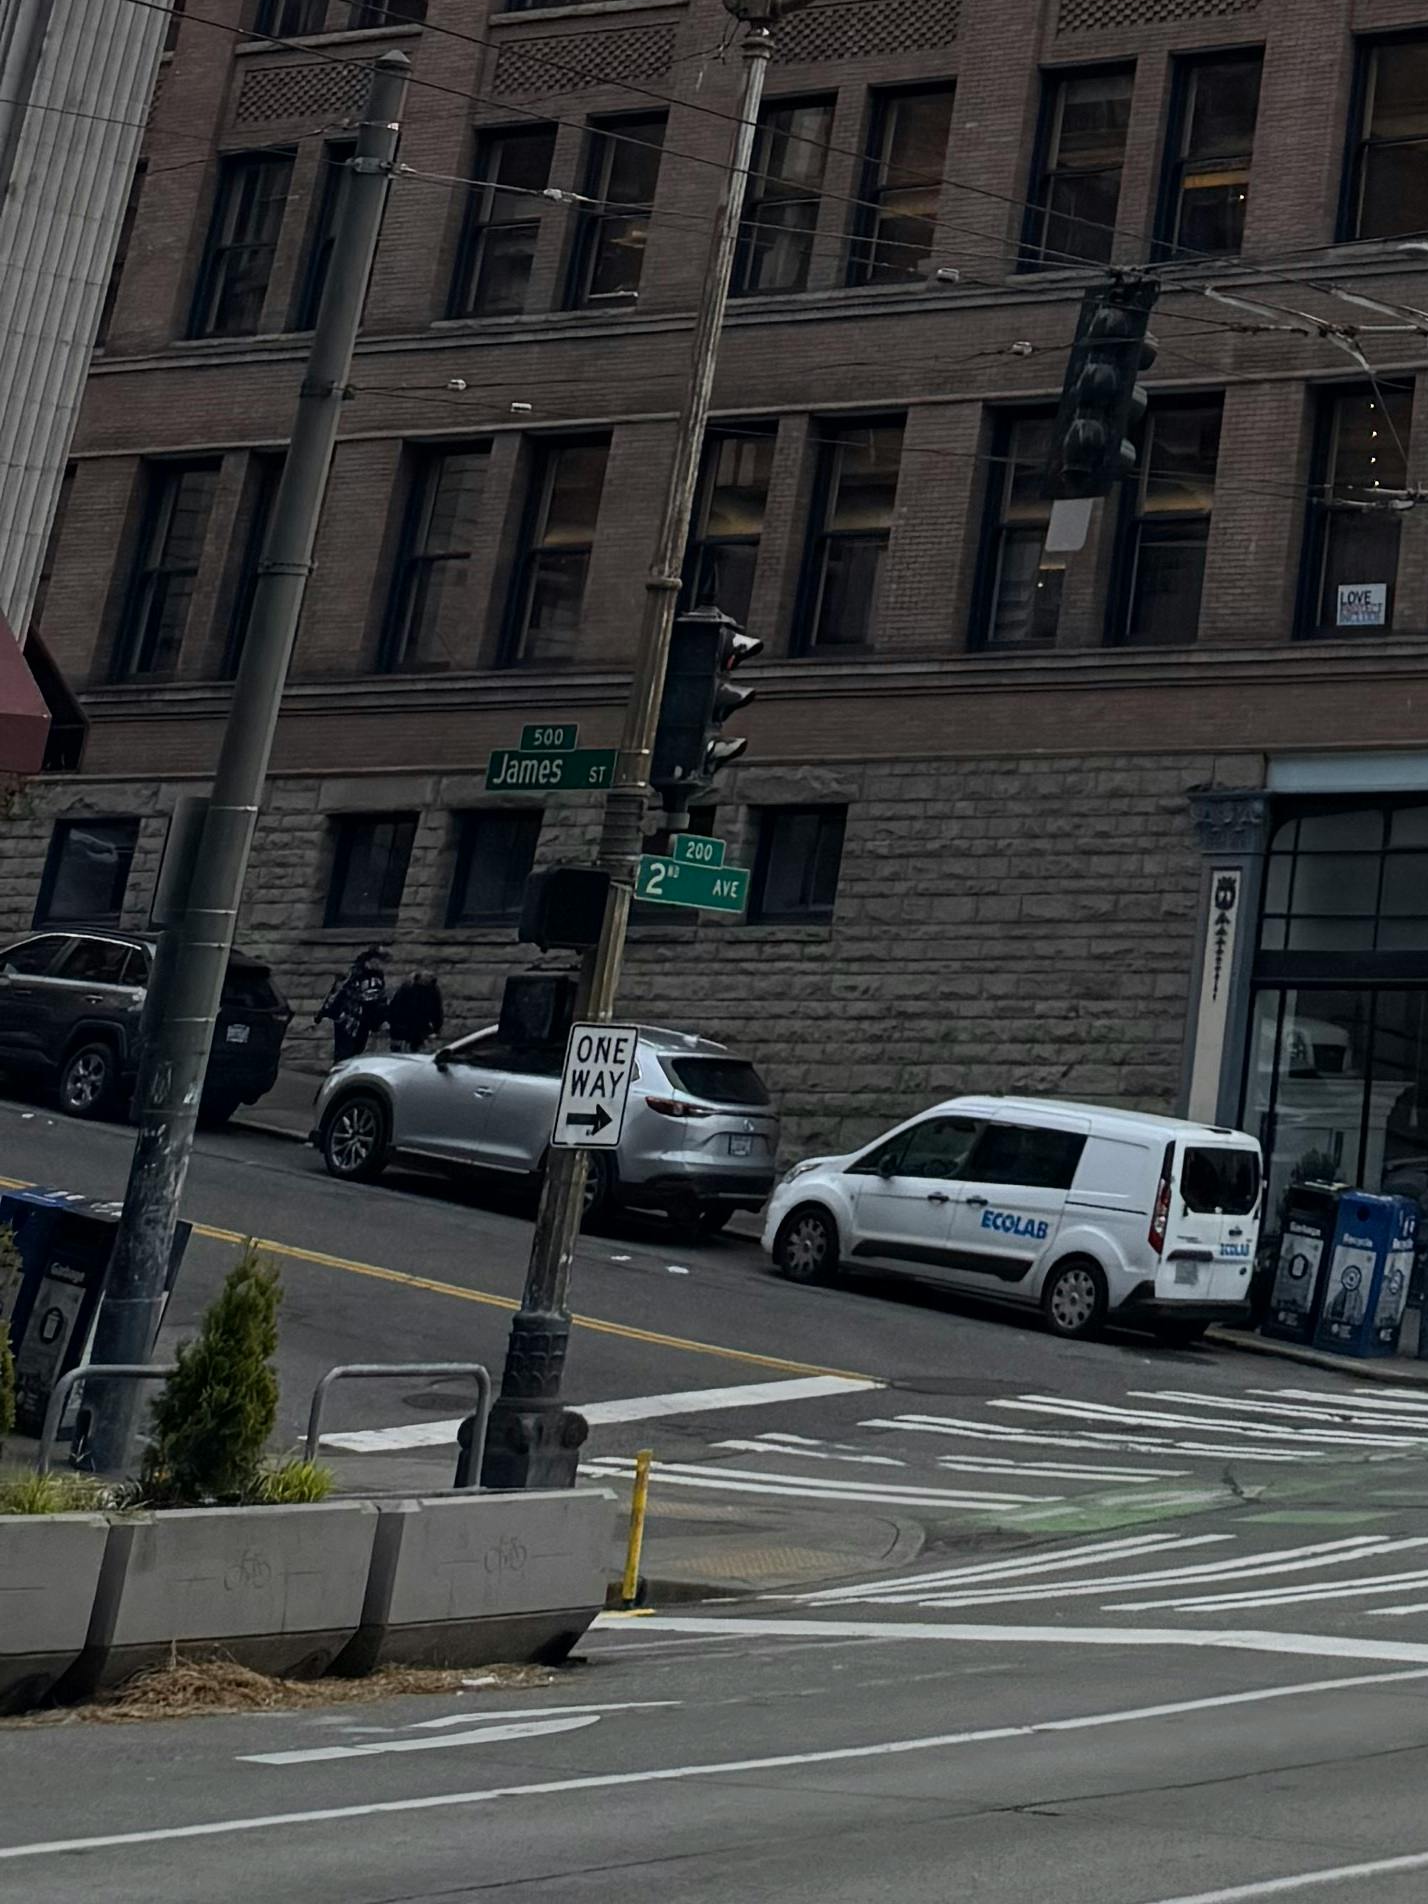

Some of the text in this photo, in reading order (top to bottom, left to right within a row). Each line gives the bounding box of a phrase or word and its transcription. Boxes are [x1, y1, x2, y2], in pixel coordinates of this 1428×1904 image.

[1340, 589, 1372, 606] LOVE
[534, 728, 564, 745] 500
[492, 753, 607, 784] James ST
[686, 841, 713, 861] 200
[712, 879, 739, 898] AVE
[577, 1035, 629, 1065] ONE
[570, 1069, 625, 1099] WAY
[981, 1209, 1049, 1240] ECOLAB
